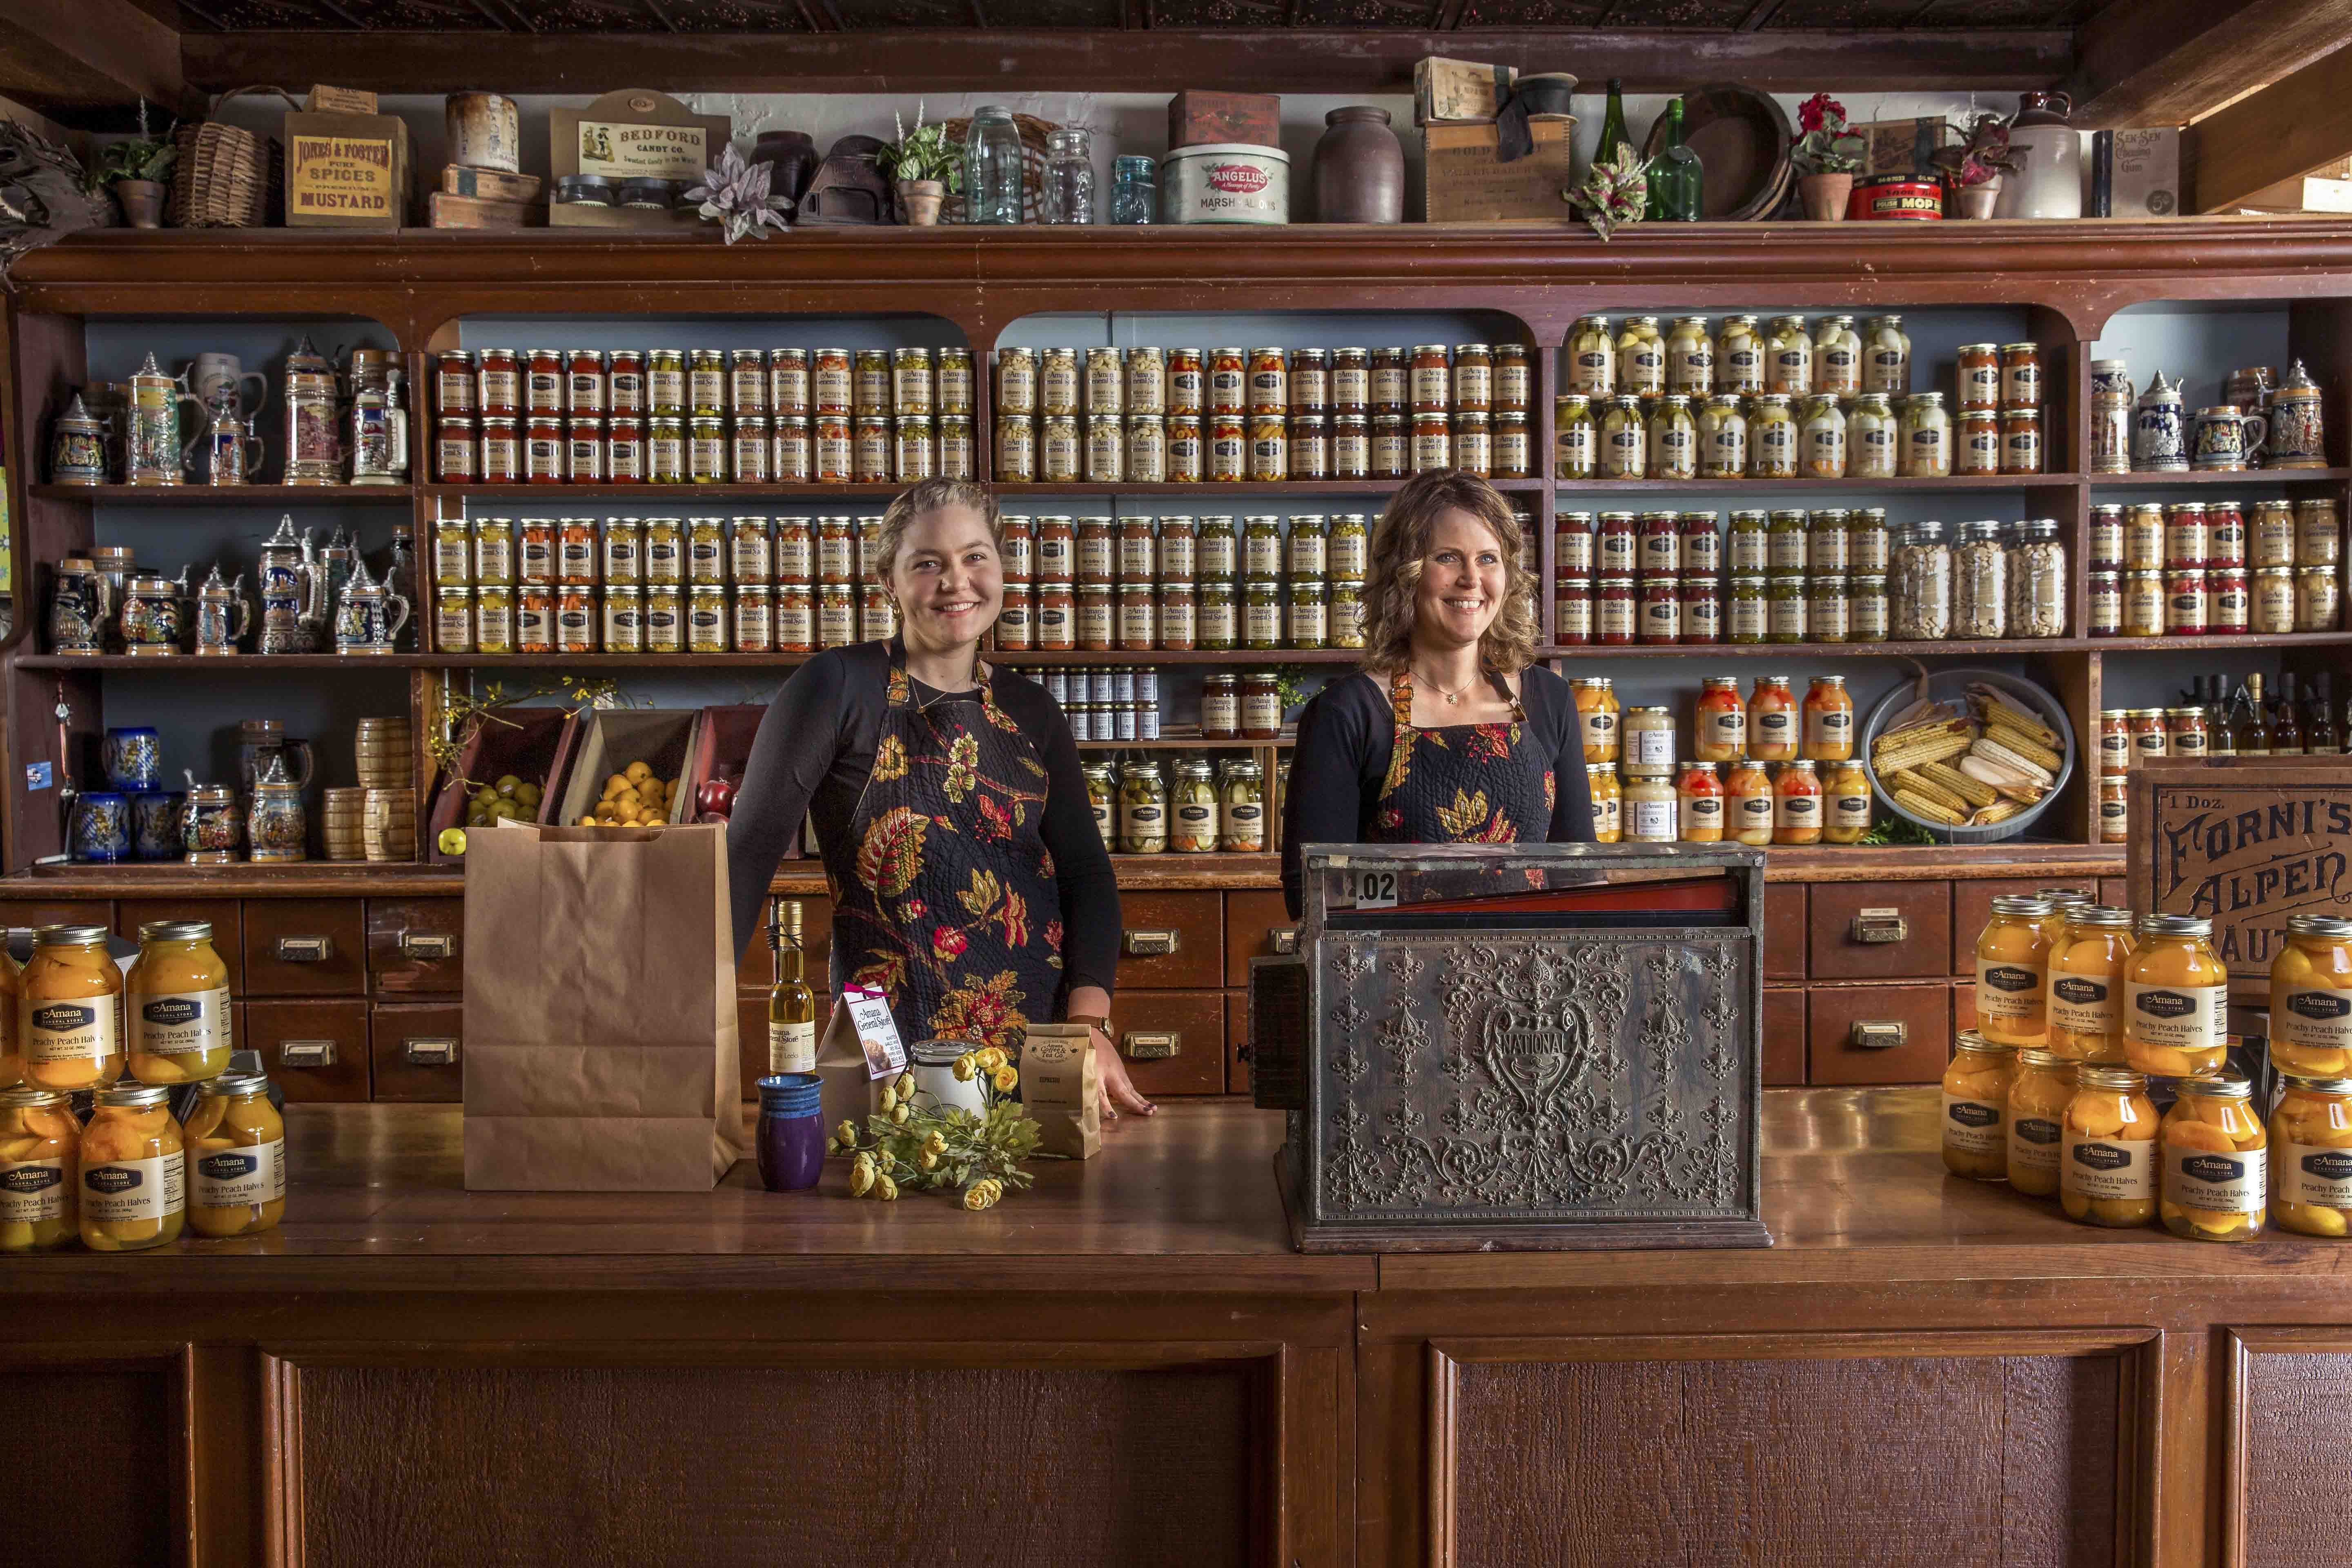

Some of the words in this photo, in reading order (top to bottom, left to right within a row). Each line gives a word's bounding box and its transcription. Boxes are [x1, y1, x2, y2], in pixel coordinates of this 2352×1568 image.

[620, 129, 700, 145] BEDFORD
[637, 145, 668, 153] CANDY
[296, 141, 331, 174] JONES
[334, 143, 341, 157] &
[344, 143, 390, 171] FOSTER
[2121, 160, 2143, 173] Gum
[310, 168, 376, 182] SPICES
[1213, 171, 1265, 184] ANGELUS
[301, 193, 384, 209] MUSTARD
[1902, 198, 1933, 209] MOP
[2169, 798, 2178, 808] 1
[2186, 796, 2225, 809] Doz.
[2162, 799, 2352, 900] FORNI'S
[2188, 852, 2352, 915] ALPEN
[1993, 970, 2026, 980] Amana
[2061, 981, 2094, 992] Amana
[1984, 993, 2002, 1004] Peachy
[2004, 996, 2022, 1004] Peach
[2146, 994, 2183, 1004] Amana
[2297, 996, 2337, 1007] Amana
[153, 1003, 191, 1013] Amana
[2053, 1006, 2070, 1016] Peachy
[2071, 1009, 2090, 1018] Peach
[42, 1009, 82, 1019] Amana
[860, 1008, 882, 1020] Amana
[858, 1018, 878, 1031] General
[877, 1016, 891, 1029] Store
[2136, 1020, 2156, 1031] Peachy
[2158, 1023, 2179, 1032] Peach
[2180, 1025, 2203, 1033] Halves
[2286, 1022, 2309, 1033] Peachy
[2311, 1025, 2333, 1034] Peach
[33, 1037, 55, 1047] Peachy
[57, 1036, 79, 1045] Peach
[81, 1034, 104, 1043] Halvs
[144, 1031, 167, 1042] Peachy
[168, 1030, 189, 1038] Peach
[781, 1035, 799, 1044] Store
[1502, 1032, 1566, 1055] NATIONAL
[1956, 1105, 1987, 1116] Amana
[2023, 1122, 2056, 1132] Amana
[1966, 1130, 1984, 1140] Peach
[2082, 1147, 2118, 1158] Amana
[209, 1158, 245, 1167] Amana
[2193, 1159, 2232, 1170] Amana
[2314, 1156, 2352, 1165] Amana
[9, 1170, 49, 1181] Amana
[92, 1171, 128, 1180] Amana
[2094, 1175, 2114, 1184] Peach
[221, 1184, 241, 1193] Peach
[243, 1182, 264, 1191] Halves
[2182, 1184, 2206, 1195] Peachy
[2207, 1189, 2228, 1197] Peach
[2230, 1189, 2250, 1197] Halves
[2301, 1183, 2327, 1194] Peachy
[23, 1197, 46, 1207] Peach
[47, 1195, 69, 1204] Halves
[105, 1199, 125, 1207] Peach
[127, 1197, 151, 1207] Halves
